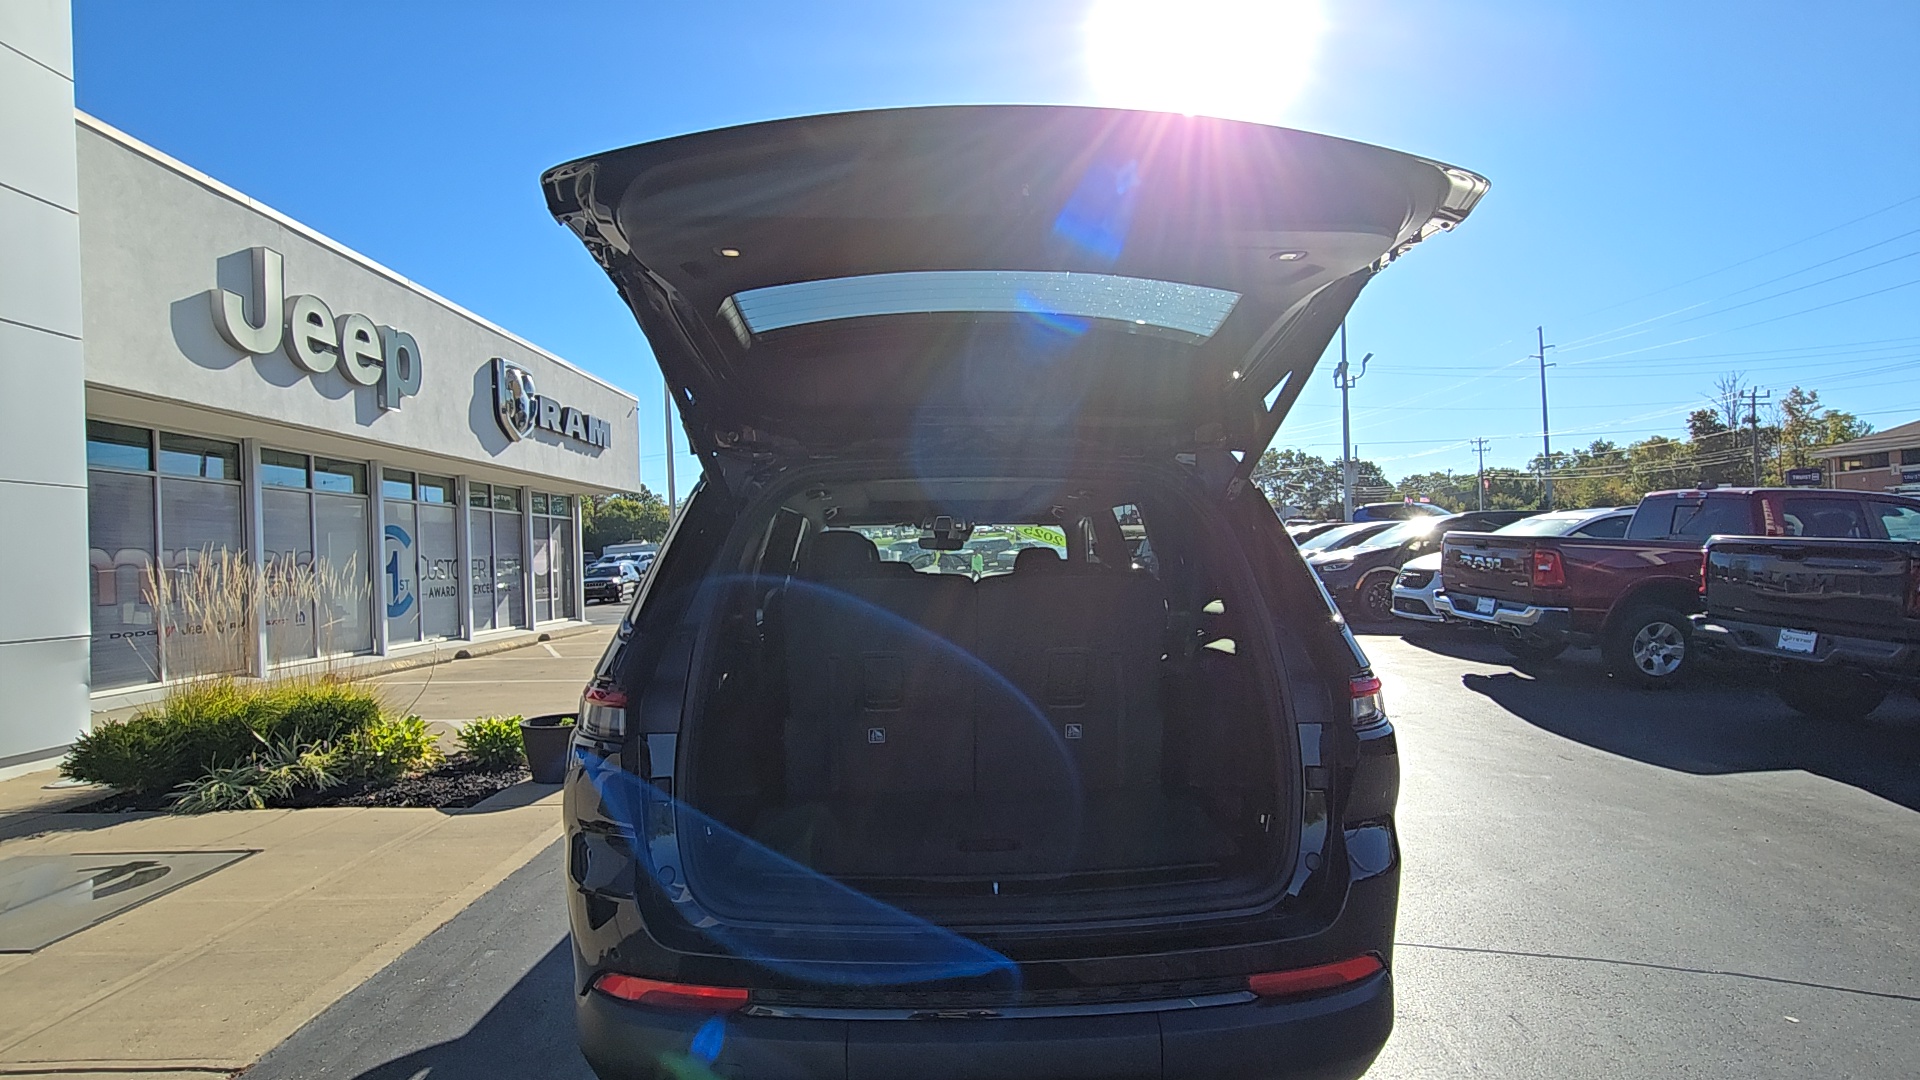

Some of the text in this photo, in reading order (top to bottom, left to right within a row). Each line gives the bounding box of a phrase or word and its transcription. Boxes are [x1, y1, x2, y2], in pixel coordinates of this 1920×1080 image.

[209, 246, 422, 412] Jeep
[535, 394, 612, 449] RAM
[415, 554, 487, 581] CUSTOER
[428, 586, 456, 599] AWARD
[110, 629, 158, 639] DODG
